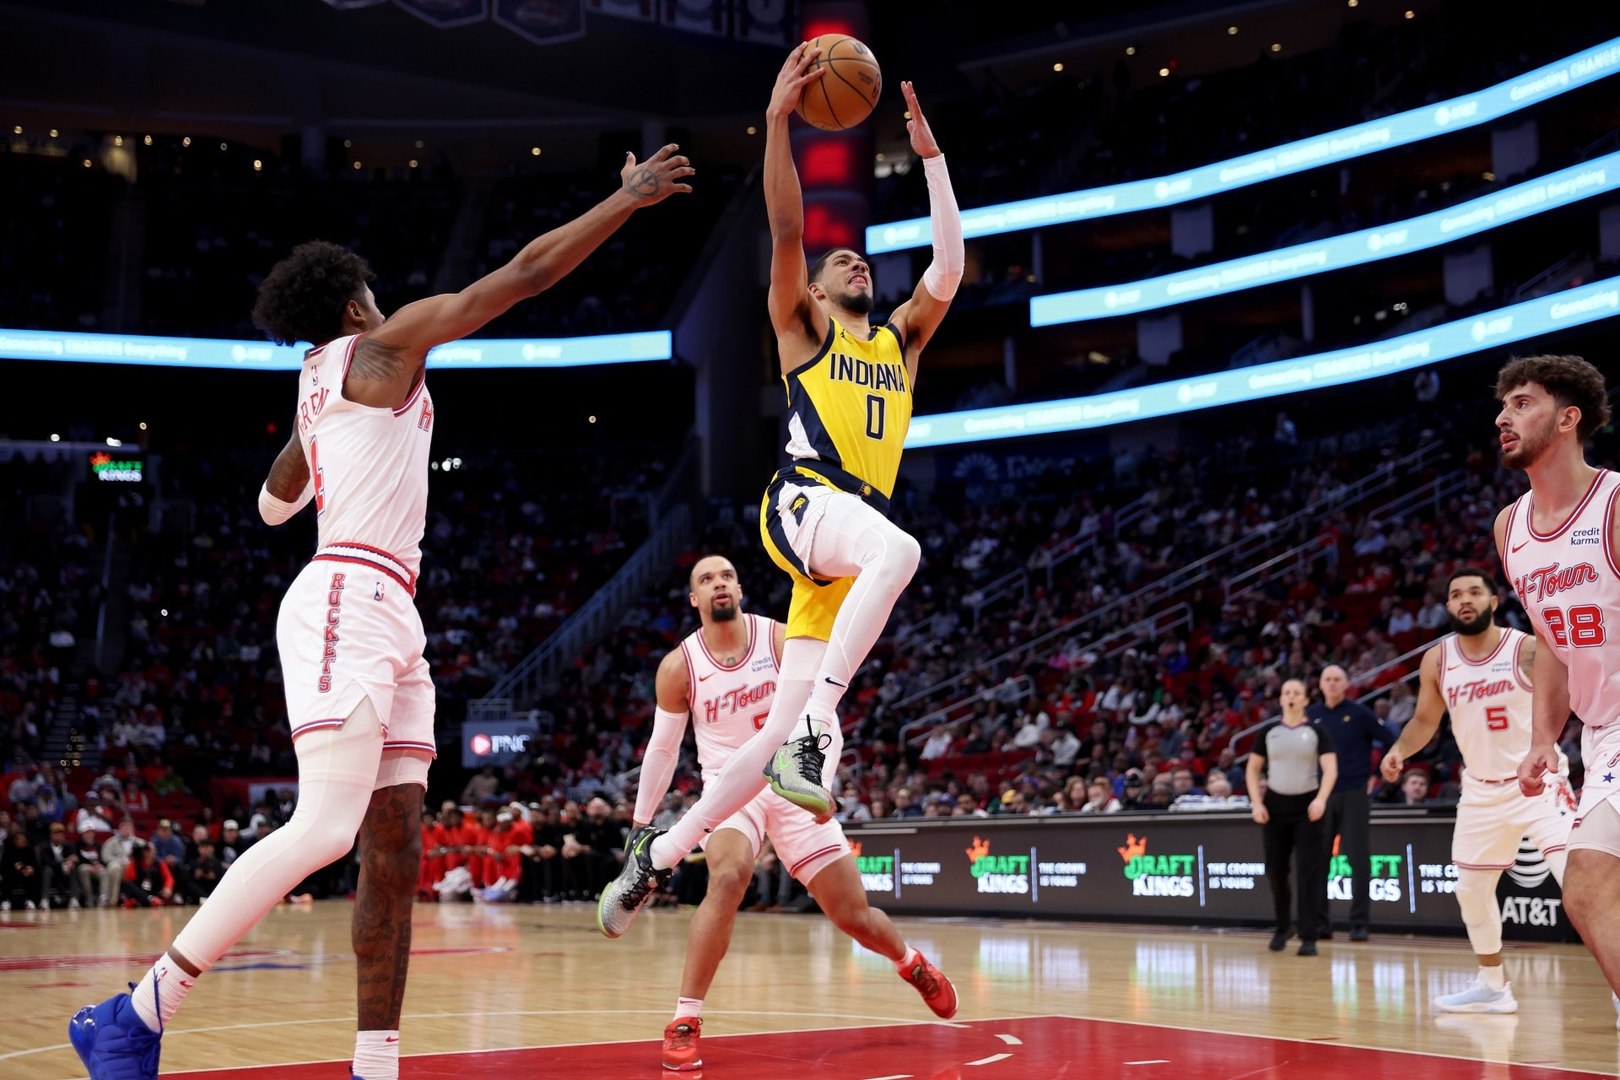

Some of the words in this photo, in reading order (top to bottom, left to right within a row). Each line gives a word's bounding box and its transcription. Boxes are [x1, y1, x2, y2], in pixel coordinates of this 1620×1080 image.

[829, 352, 906, 393] INDIANA
[866, 393, 885, 441] 0
[1570, 537, 1600, 546] karma
[1573, 527, 1600, 537] credit
[1514, 562, 1600, 610] H-Town
[318, 573, 346, 693] ROCKETS
[1541, 603, 1607, 649] 28
[704, 681, 777, 724] H-Town
[1447, 679, 1515, 709] H-Town
[1485, 706, 1509, 732] 5
[971, 855, 1029, 878] DRAFT
[1124, 855, 1195, 880] DRAFT
[1207, 863, 1226, 875] THE
[1419, 864, 1442, 878] THE
[977, 873, 1029, 894] KINGS
[1133, 874, 1195, 897] KINGS
[1327, 875, 1402, 901] KIGS
[1421, 880, 1435, 893] IS
[1502, 896, 1562, 927] AT&T
